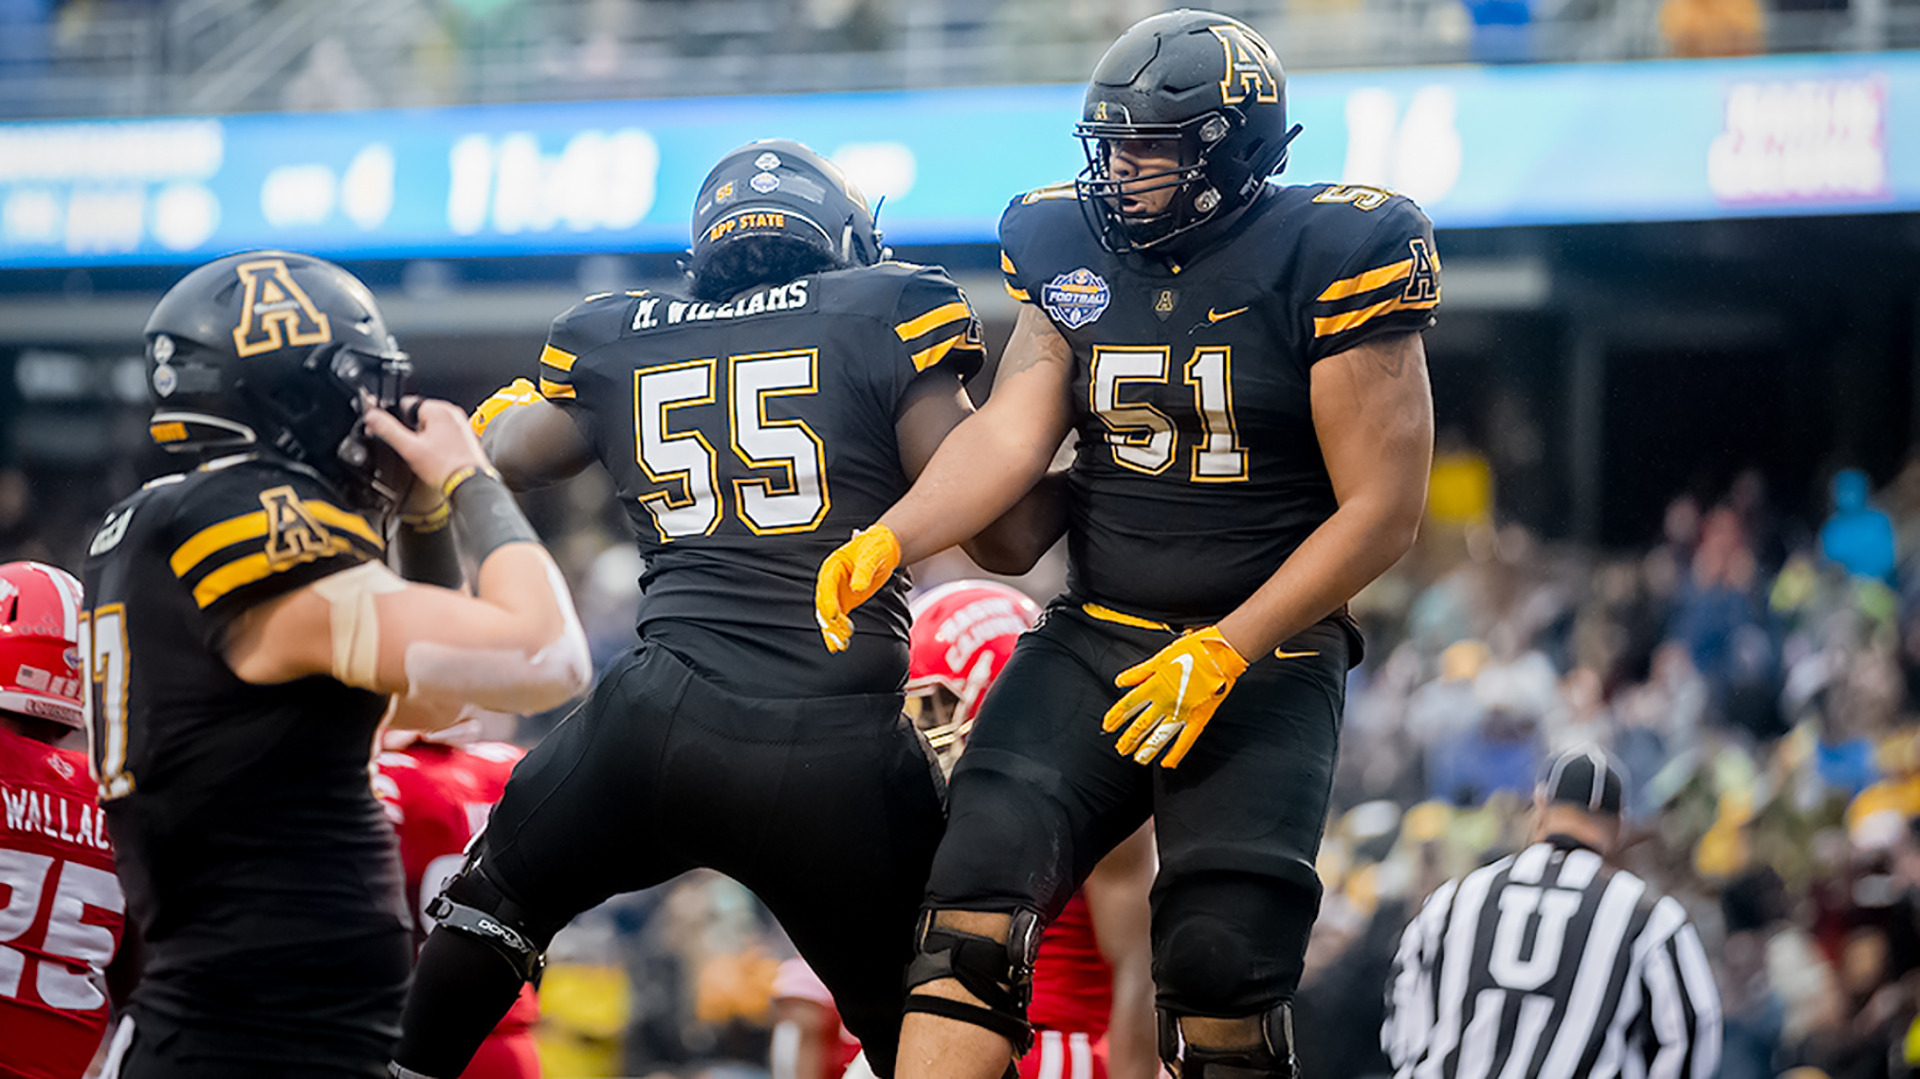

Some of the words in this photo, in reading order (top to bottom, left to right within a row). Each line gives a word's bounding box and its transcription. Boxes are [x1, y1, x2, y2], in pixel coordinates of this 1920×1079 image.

[1207, 24, 1279, 105] A
[709, 219, 737, 243] APP
[739, 212, 786, 230] STATE
[715, 182, 734, 203] 55
[667, 279, 809, 324] WILLIAMS
[1048, 290, 1105, 305] FOOTBALL
[1403, 237, 1437, 300] A
[232, 259, 331, 357] A
[633, 347, 831, 543] 55
[1088, 344, 1249, 482] 51
[258, 485, 334, 566] A
[1, 786, 110, 850] WALLAC
[1487, 884, 1583, 992] U
